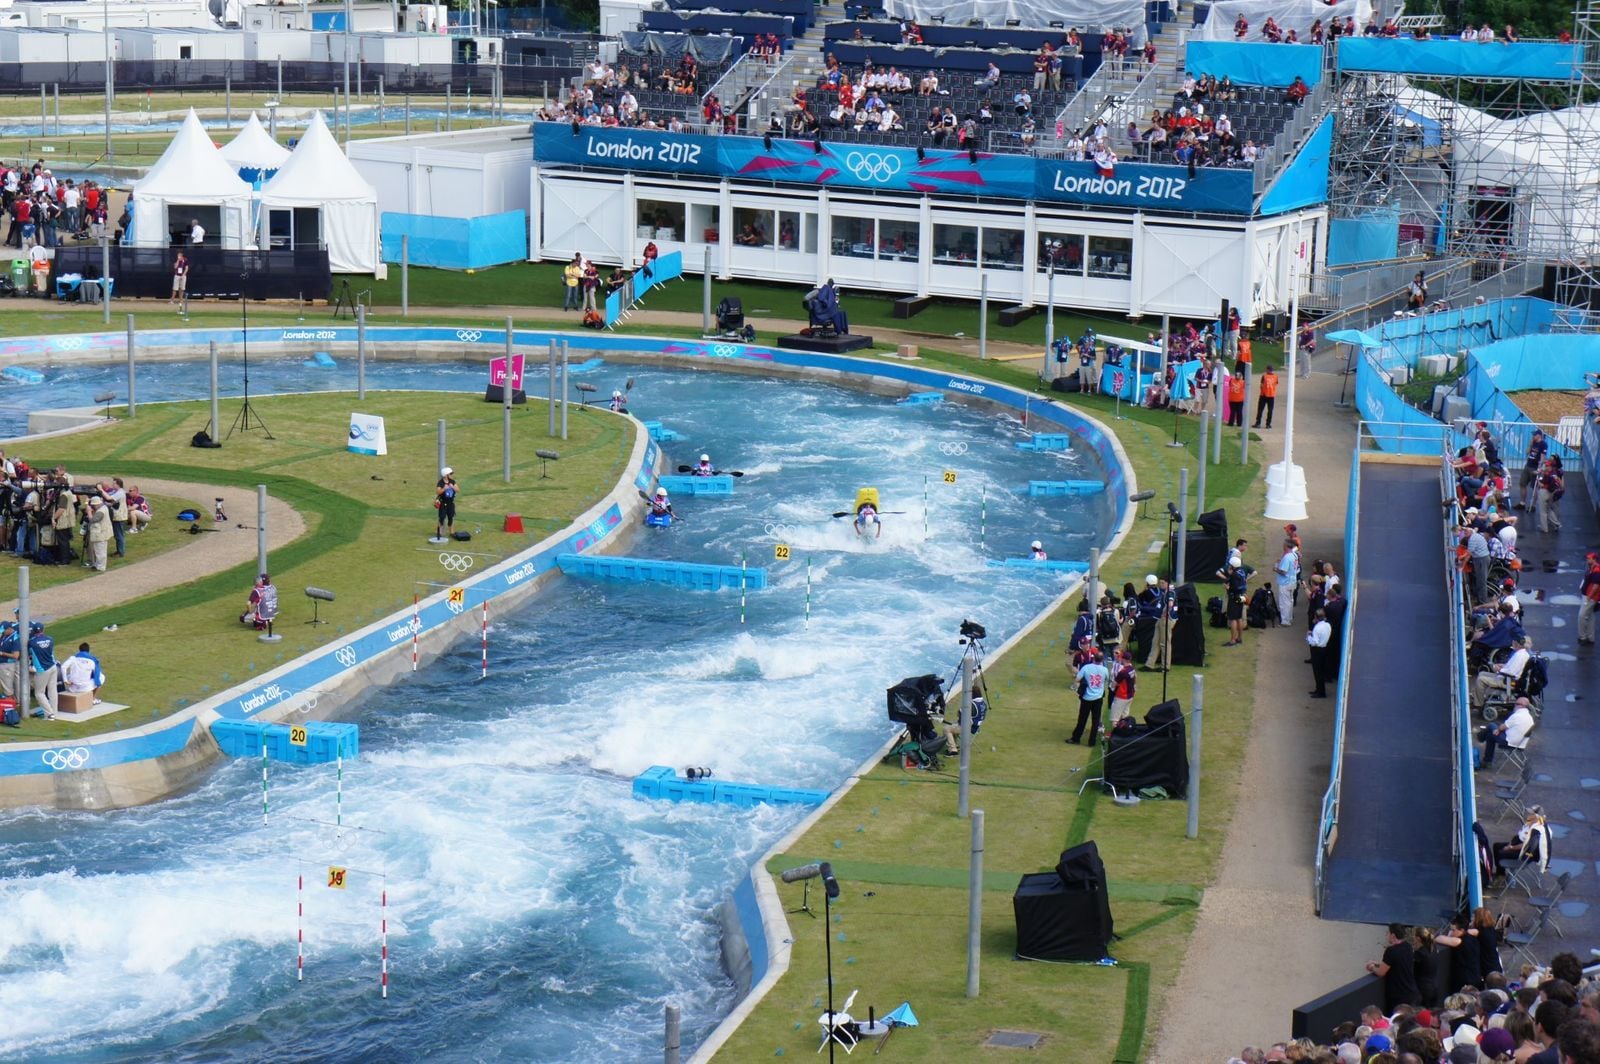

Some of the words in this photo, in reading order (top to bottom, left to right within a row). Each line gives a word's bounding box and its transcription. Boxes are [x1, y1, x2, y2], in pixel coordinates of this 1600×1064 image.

[587, 136, 654, 161] London
[658, 141, 701, 164] 2012
[1054, 170, 1131, 196] London
[1136, 175, 1186, 199] 2012
[283, 330, 315, 339] London
[316, 331, 337, 339] 2012
[944, 472, 956, 483] 23
[776, 547, 788, 558] 22
[450, 590, 463, 601] 21
[240, 693, 268, 713] London
[291, 728, 306, 743] 20
[330, 870, 343, 886] 19
